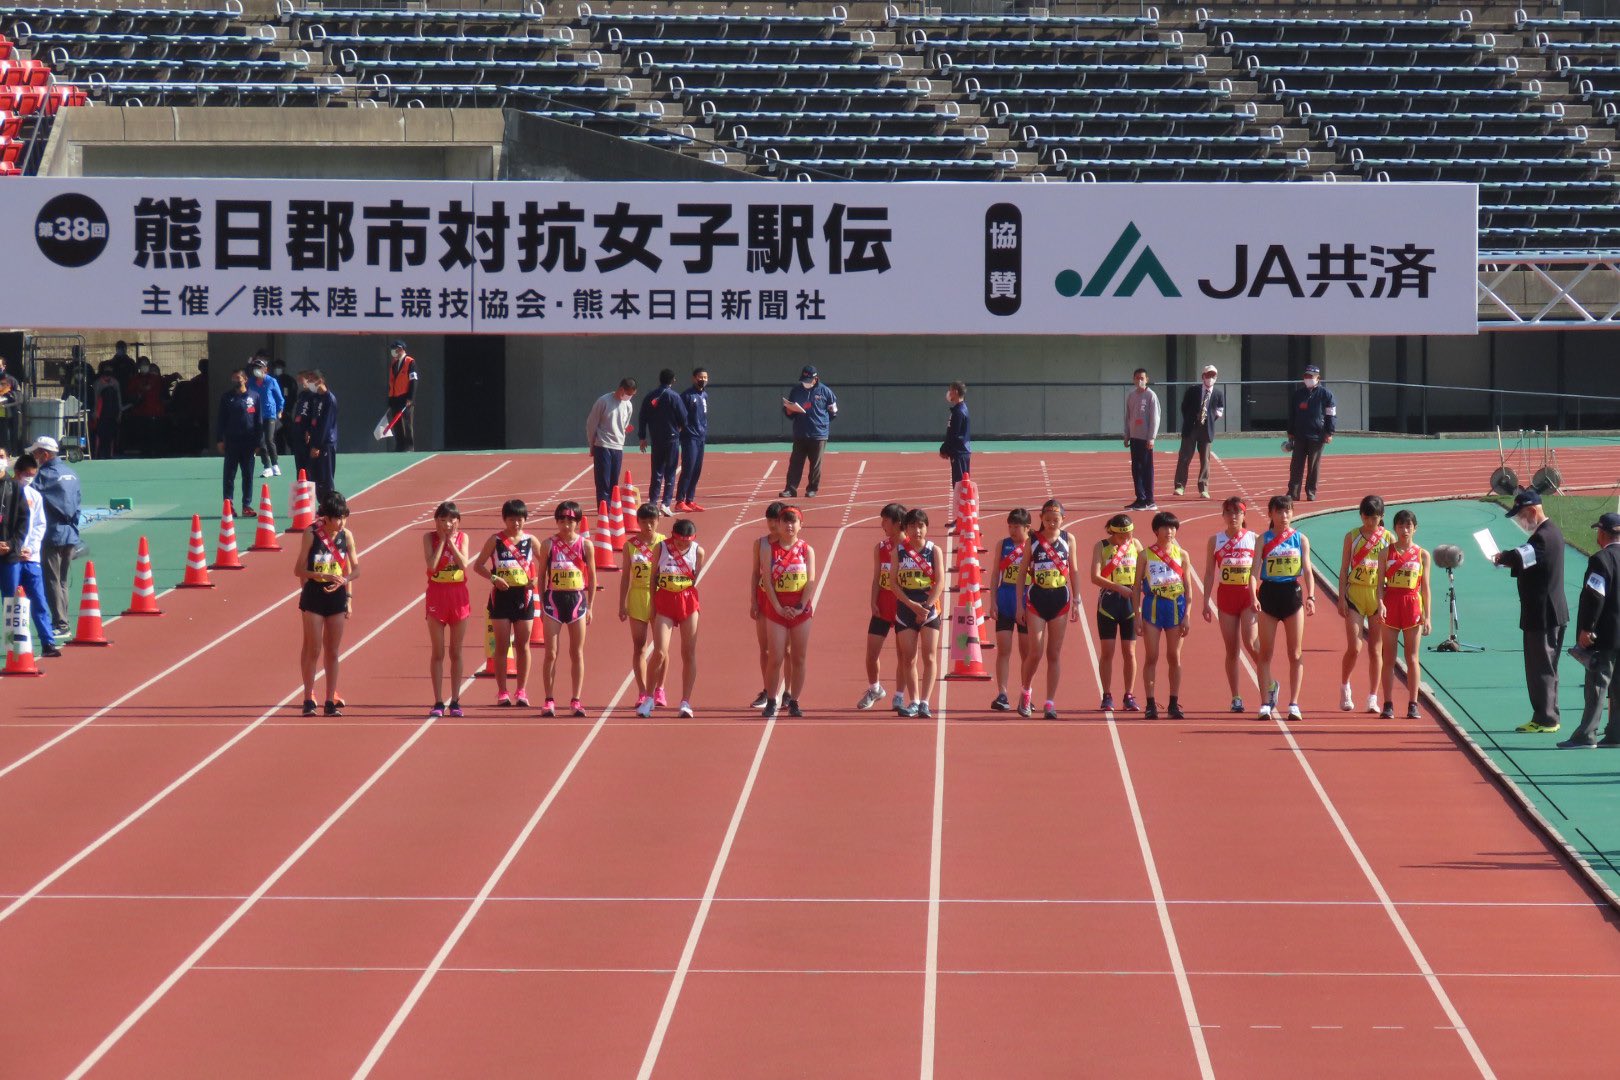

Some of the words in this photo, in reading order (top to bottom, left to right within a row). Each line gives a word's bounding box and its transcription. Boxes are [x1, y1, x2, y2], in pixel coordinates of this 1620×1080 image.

[38, 217, 106, 241] 第38回
[134, 197, 891, 274] 熊日郡市対抗女子駅伝
[990, 222, 1017, 299] 協賛
[1198, 244, 1436, 299] JA共済
[634, 565, 642, 579] 2
[1267, 559, 1275, 573] 7
[551, 572, 560, 586] 4
[1221, 567, 1230, 581] 6
[659, 576, 667, 588] 5
